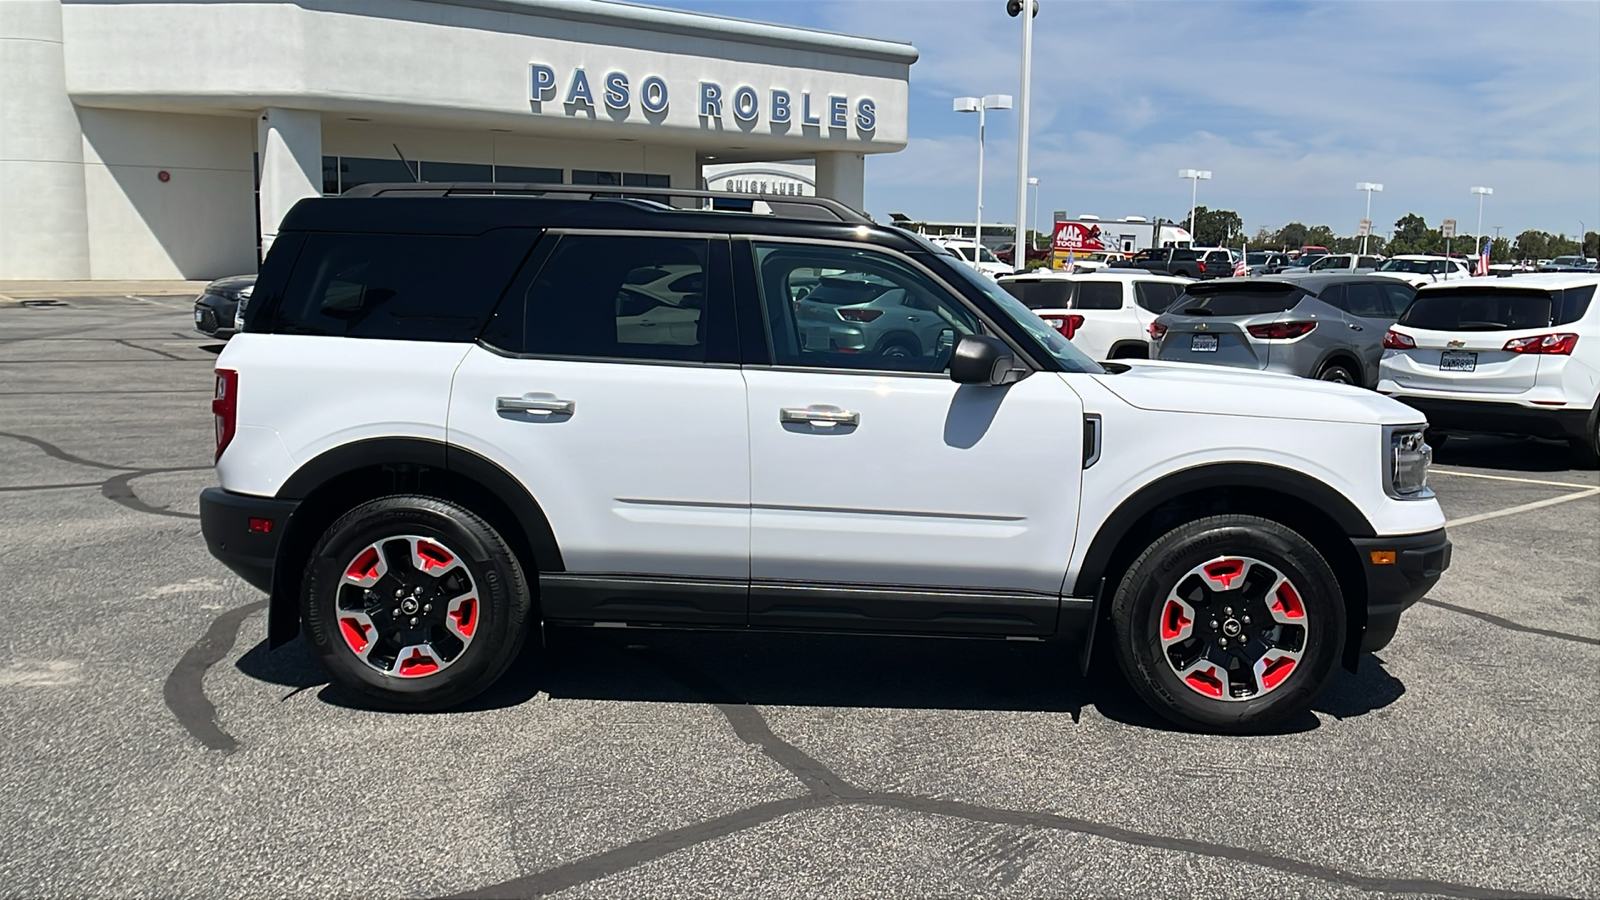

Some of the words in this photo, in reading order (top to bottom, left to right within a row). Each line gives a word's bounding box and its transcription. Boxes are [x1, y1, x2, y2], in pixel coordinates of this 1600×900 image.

[529, 63, 669, 113] PASO
[699, 81, 877, 132] ROBLES
[726, 179, 767, 191] QUICK
[772, 181, 803, 193] LUBE
[1057, 225, 1083, 242] MAC
[1056, 240, 1083, 248] TOOLS
